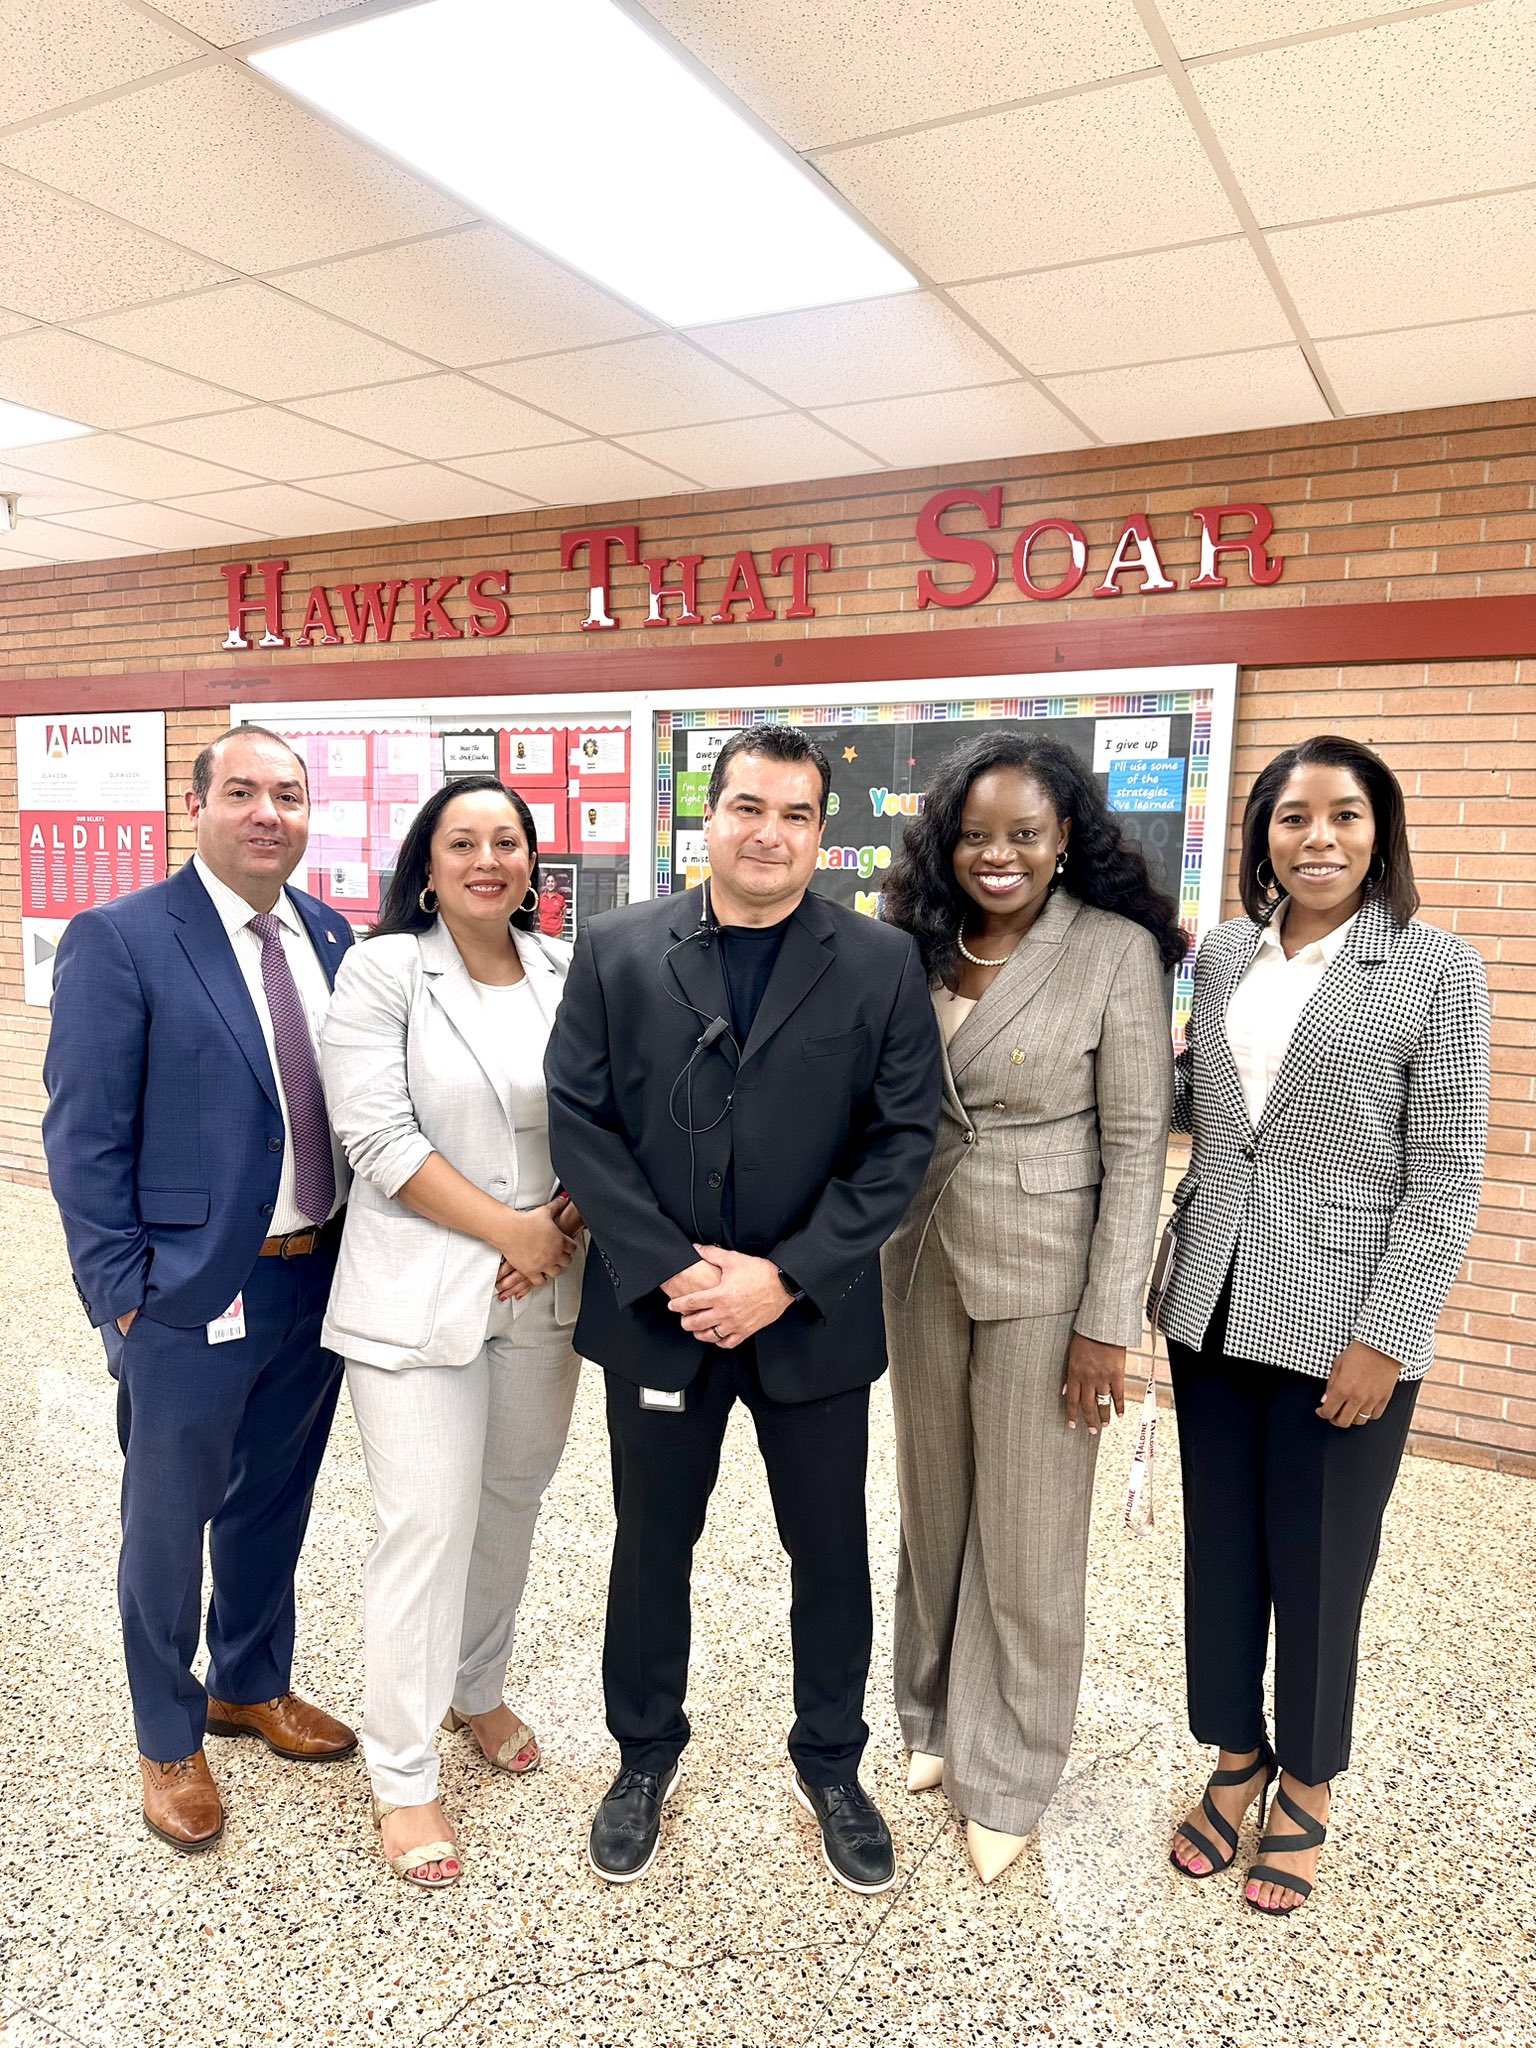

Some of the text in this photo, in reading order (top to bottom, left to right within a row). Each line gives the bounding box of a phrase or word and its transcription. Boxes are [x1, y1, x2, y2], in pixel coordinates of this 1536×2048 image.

[559, 525, 832, 632] THAT
[914, 486, 1284, 609] SOAR
[71, 725, 132, 745] ALDINE
[1105, 739, 1158, 752] I give up
[701, 763, 712, 771] at
[1114, 761, 1179, 771] I'll use some
[1127, 773, 1160, 784] of the
[682, 783, 695, 792] I'm
[1116, 786, 1169, 799] strategies
[681, 794, 701, 806] right
[1113, 799, 1175, 811] I've learned
[29, 824, 154, 851] ALDINE
[690, 853, 709, 863] mist
[1138, 1422, 1148, 1451] ALDINE
[1125, 1488, 1137, 1517] ALDINE
